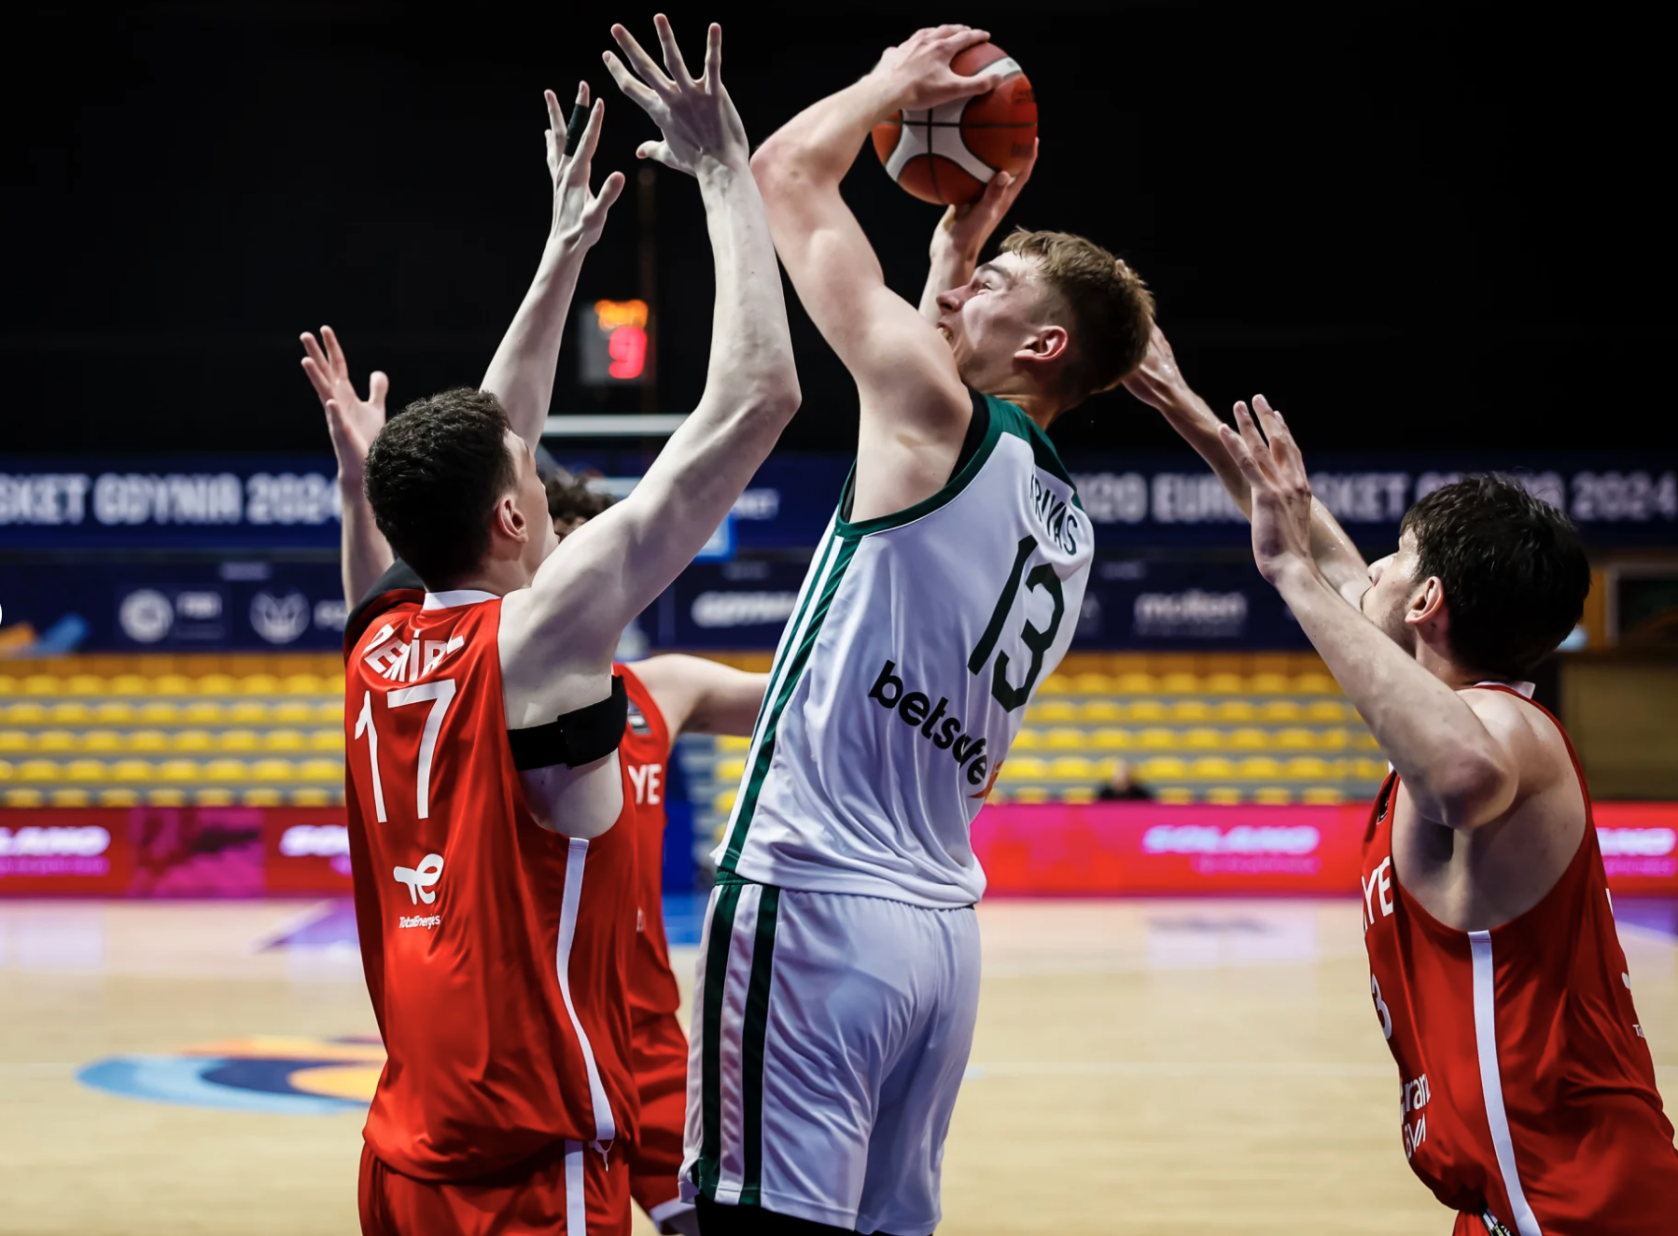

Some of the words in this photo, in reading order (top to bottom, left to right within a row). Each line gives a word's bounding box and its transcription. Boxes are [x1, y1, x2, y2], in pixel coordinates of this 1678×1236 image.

[608, 326, 648, 379] 9
[94, 472, 242, 525] GDYNIA
[1030, 474, 1078, 556] RIVAS
[1570, 472, 1677, 522] 2024
[967, 534, 1065, 713] 13
[354, 678, 457, 823] 17
